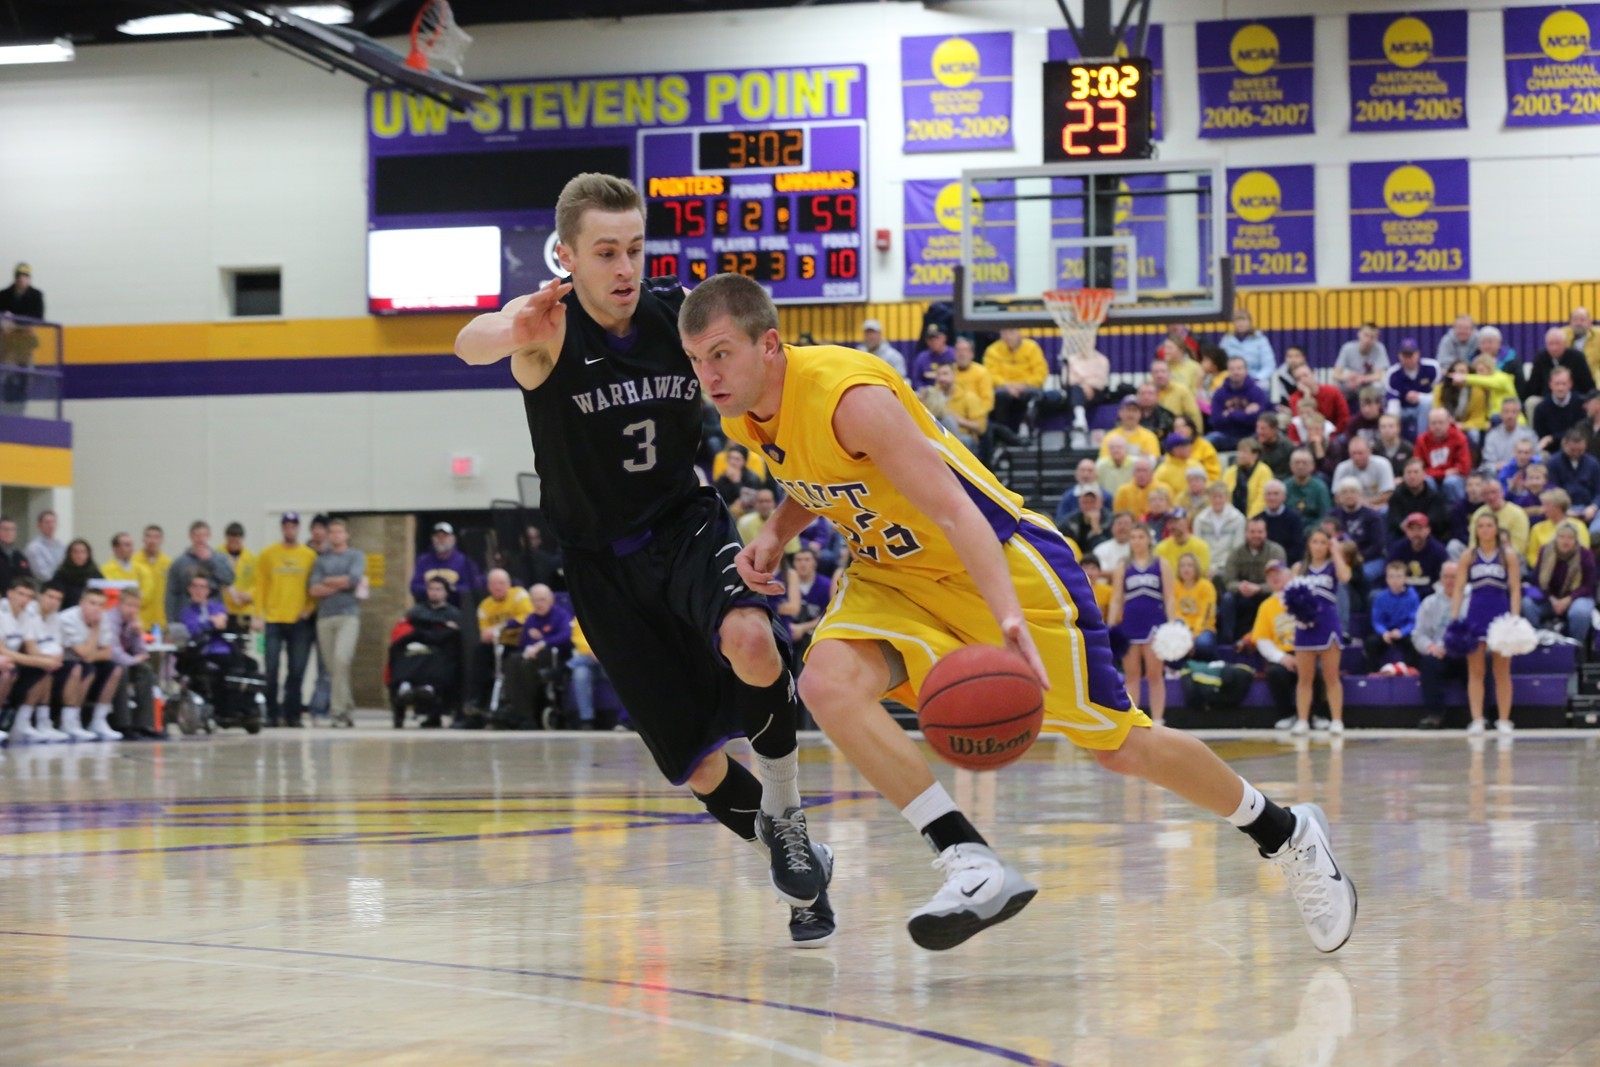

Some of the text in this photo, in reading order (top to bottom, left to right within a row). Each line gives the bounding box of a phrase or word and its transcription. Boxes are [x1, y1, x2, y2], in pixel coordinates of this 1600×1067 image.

[1390, 41, 1431, 54] NCAA
[1546, 34, 1588, 48] NCAA
[1071, 65, 1140, 99] 3:02
[1376, 71, 1440, 84] NATIONAL
[1532, 64, 1599, 78] NATIONAL
[704, 66, 860, 122] POINT
[1370, 82, 1448, 97] CHAMPIONS
[1203, 103, 1309, 129] 2006-2007
[1355, 98, 1463, 122] 2004-2005
[906, 115, 1010, 141] 2008-2009
[1062, 99, 1126, 155] 23
[728, 129, 803, 169] 3:02
[1239, 194, 1280, 208] NCAA
[1391, 189, 1432, 203] NCAA
[664, 200, 705, 237] 75
[744, 201, 761, 231] 2
[812, 194, 857, 232] 59
[1382, 219, 1438, 235] SECOND
[1385, 233, 1434, 246] ROUND
[1232, 236, 1281, 250] ROUND
[769, 250, 786, 280] 3
[802, 255, 815, 279] 3
[830, 248, 857, 278] 10
[1359, 248, 1463, 273] 2012-2013
[572, 375, 699, 414] WARHAWKS
[622, 418, 657, 473] 3
[948, 729, 1031, 756] Wilson
